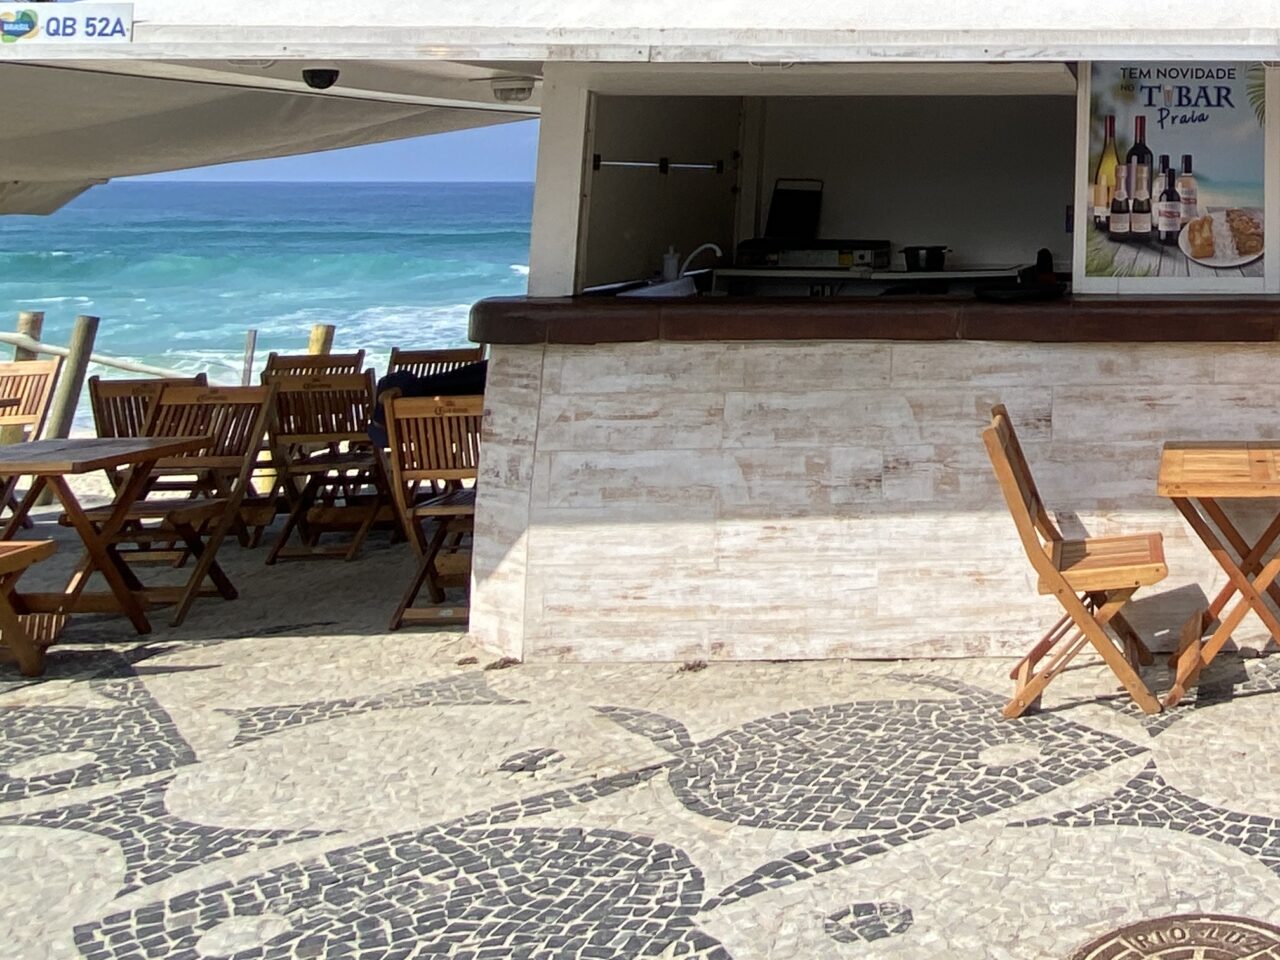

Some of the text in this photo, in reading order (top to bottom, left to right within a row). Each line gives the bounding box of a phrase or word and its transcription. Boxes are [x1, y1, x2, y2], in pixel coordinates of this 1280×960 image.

[46, 17, 126, 37] QB 52A
[1120, 67, 1237, 79] TEM NOVIDADE
[1157, 107, 1210, 130] Praia
[1130, 926, 1188, 949] RIO
